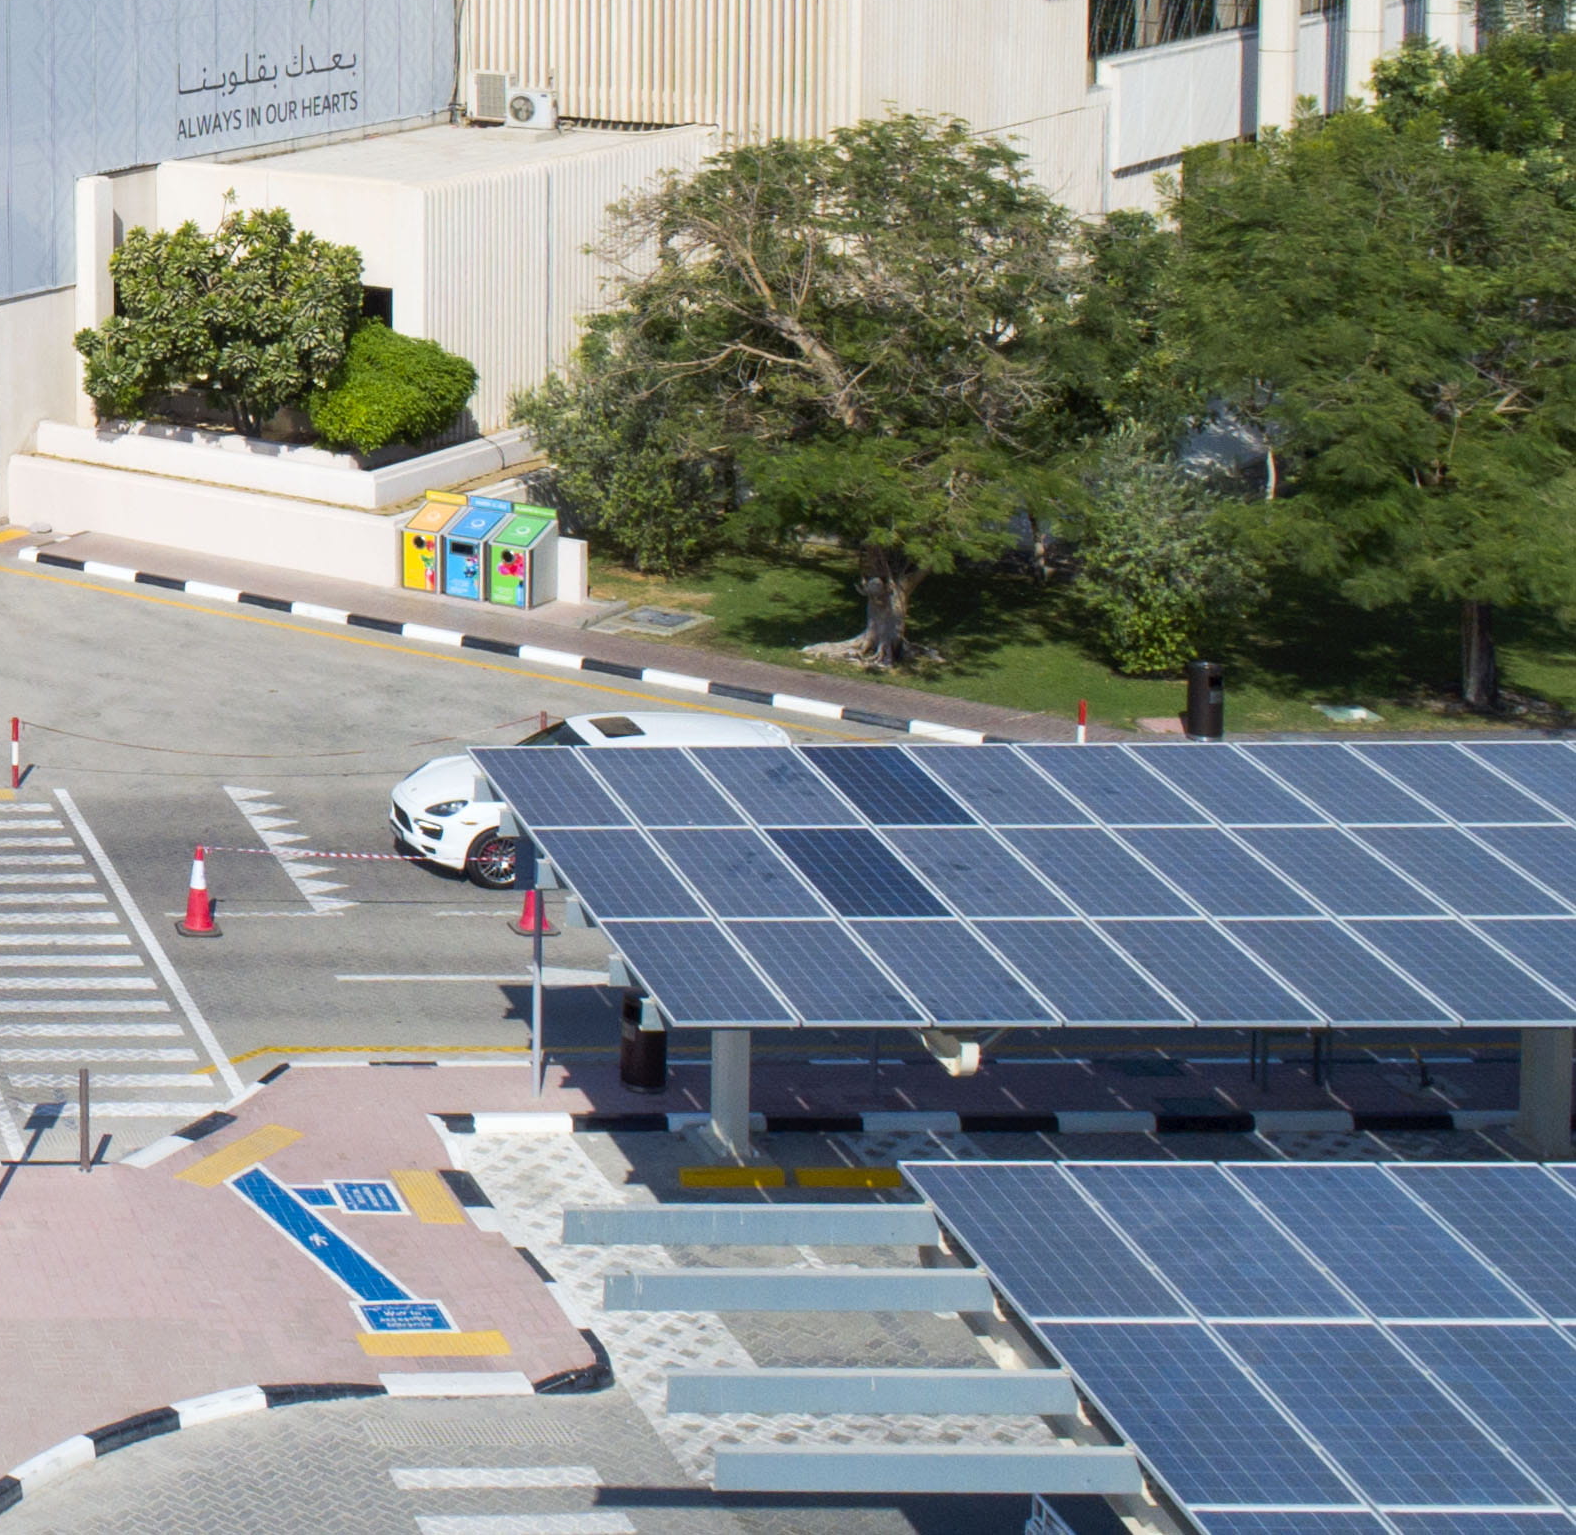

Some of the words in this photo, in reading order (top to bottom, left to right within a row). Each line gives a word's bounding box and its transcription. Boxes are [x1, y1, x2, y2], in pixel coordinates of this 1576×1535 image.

[178, 53, 278, 97] بقلوبنا
[285, 44, 357, 77] بعدك
[177, 109, 242, 141] ALWAYS
[246, 106, 261, 128] IN
[266, 100, 297, 124] OUR
[301, 91, 358, 118] HEARTS
